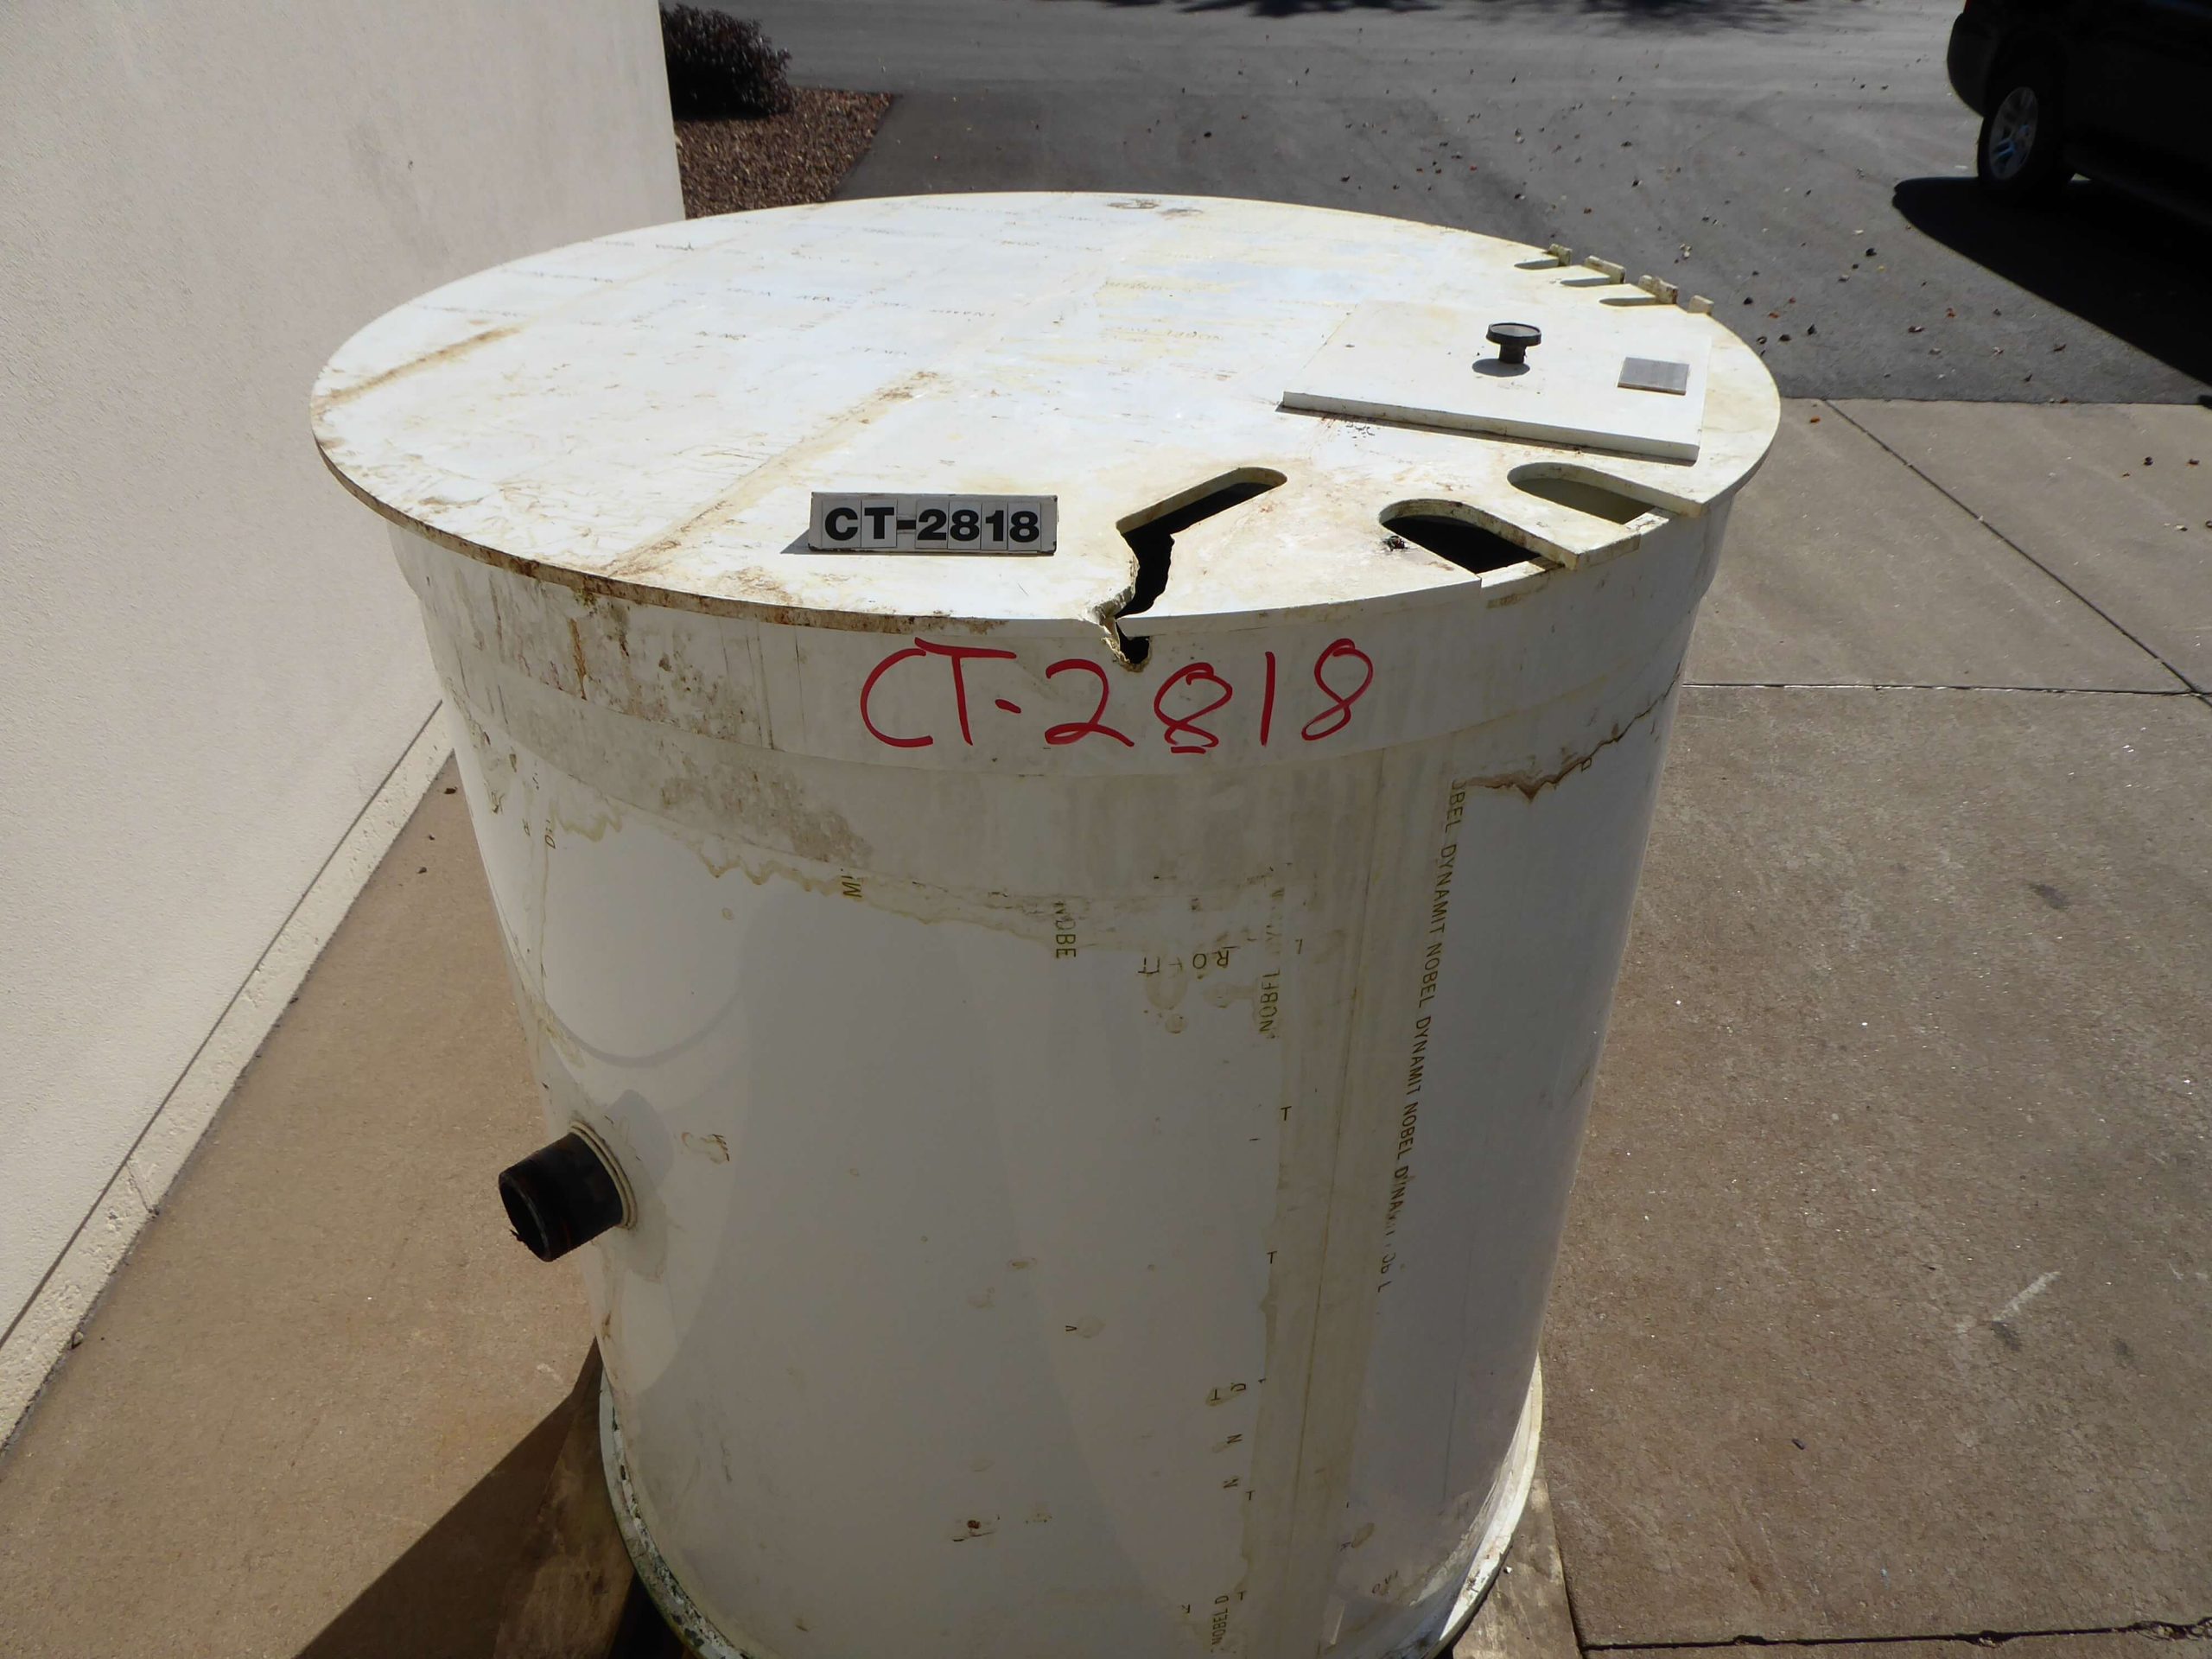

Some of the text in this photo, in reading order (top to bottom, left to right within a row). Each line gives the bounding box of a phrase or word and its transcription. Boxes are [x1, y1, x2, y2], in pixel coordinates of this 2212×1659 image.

[824, 506, 1040, 543] CT-2818
[1428, 843, 1457, 934] DYNAMIT
[1419, 942, 1442, 1008] NOBEL
[1406, 1015, 1432, 1096] DYNAMIT
[1396, 1101, 1419, 1160] NOBEL
